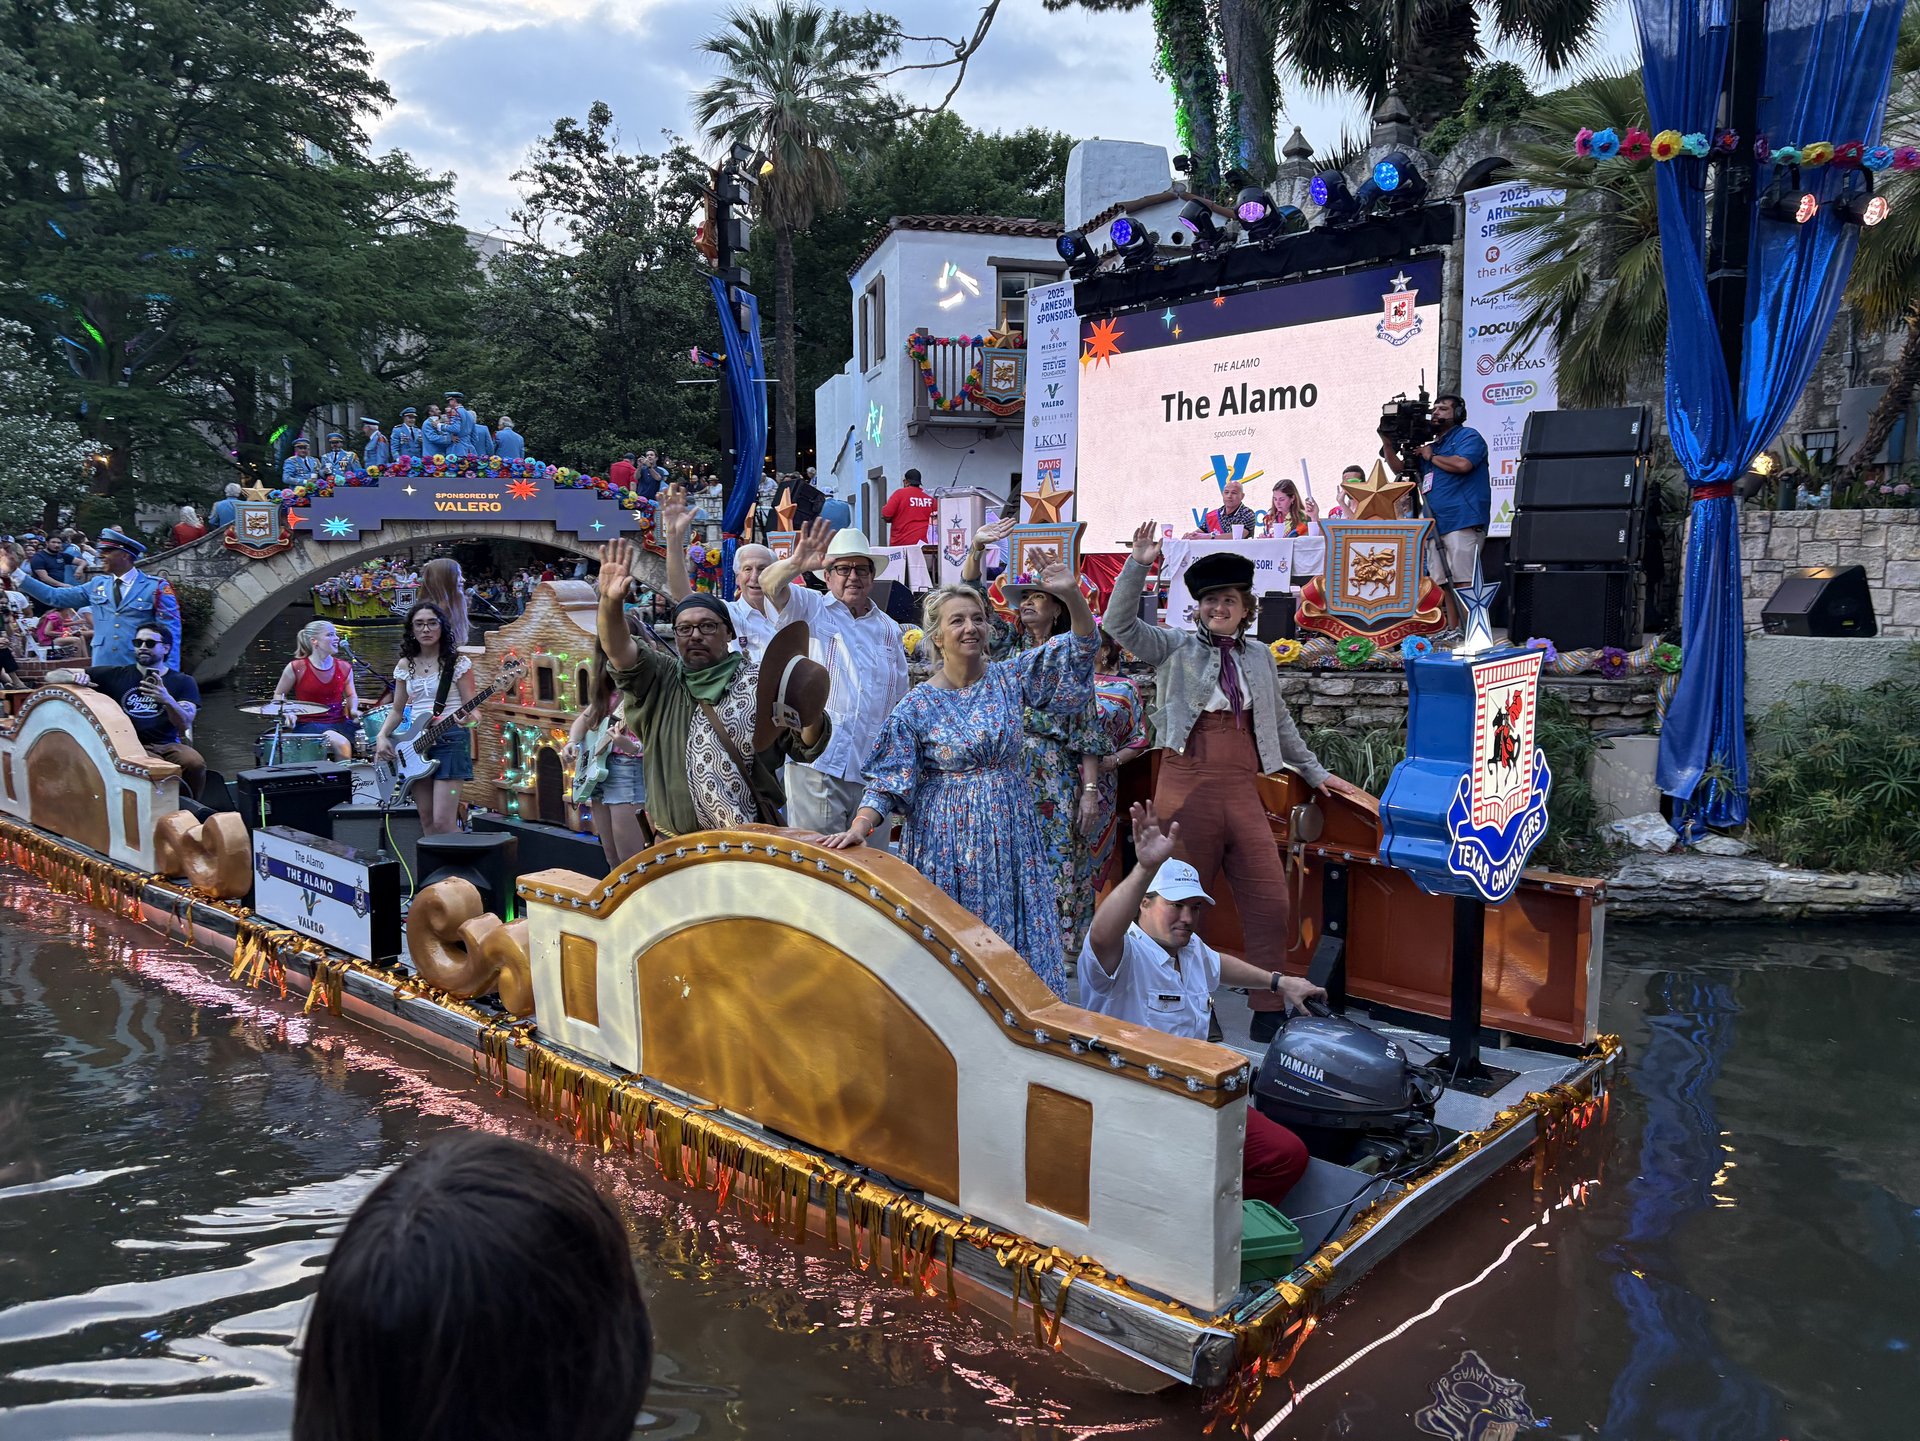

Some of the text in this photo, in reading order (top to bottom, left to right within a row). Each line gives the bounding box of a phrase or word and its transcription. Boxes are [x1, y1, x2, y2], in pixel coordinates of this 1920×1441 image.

[1500, 186, 1531, 203] 2025
[1477, 268, 1497, 278] the
[1047, 287, 1065, 300] 2025
[1040, 297, 1072, 313] ARNESON
[1470, 294, 1500, 309] Mays
[1037, 308, 1075, 324] SPONSORS!
[1041, 341, 1067, 350] MISSION
[1042, 359, 1066, 371] STEVES
[1213, 357, 1261, 373] THE ALAMO
[1496, 358, 1546, 373] OF TEXAS
[1487, 385, 1533, 399] CENTRO
[1041, 399, 1064, 408] VALERO
[1161, 382, 1318, 422] The Alamo
[1035, 433, 1067, 447] LKCM
[1213, 427, 1257, 440] sponsored by
[1038, 460, 1061, 470] DAVIS
[433, 501, 502, 512] VALERO
[909, 496, 932, 508] STAFF
[1370, 623, 1428, 646] NTONIO
[1458, 811, 1541, 892] TEXAS CAVALIERS
[295, 850, 325, 870] The Alamo
[286, 866, 334, 894] THE ALAMO
[297, 915, 324, 935] VALERO
[1280, 1052, 1324, 1082] YAMAHA
